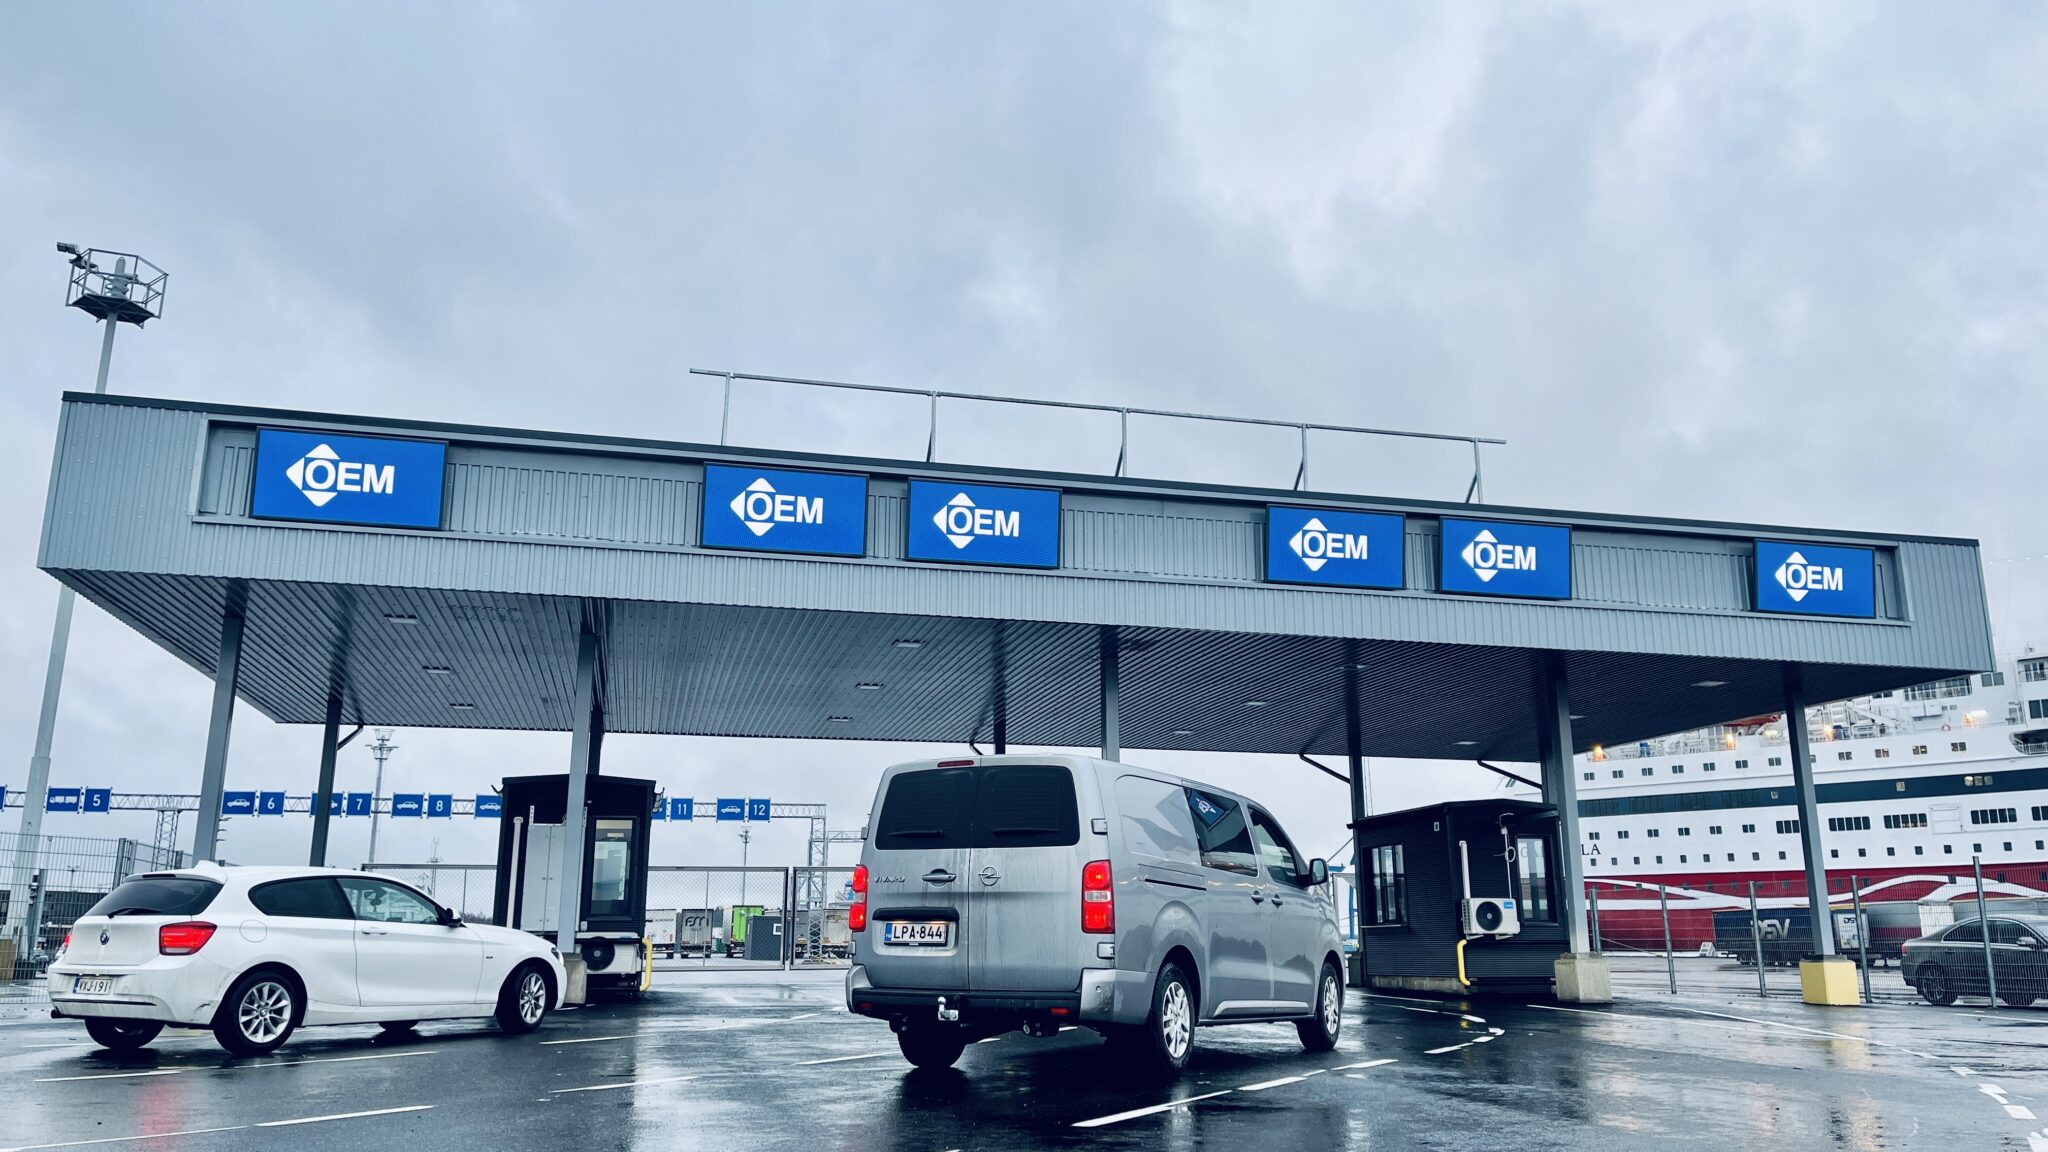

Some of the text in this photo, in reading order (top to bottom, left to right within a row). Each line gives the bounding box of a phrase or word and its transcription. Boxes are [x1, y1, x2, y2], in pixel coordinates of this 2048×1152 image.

[304, 459, 395, 494] OEM
[746, 492, 824, 524] OEM
[948, 507, 1020, 537] OEM
[1302, 531, 1368, 560] OEM
[1474, 543, 1536, 571] OEM
[1786, 564, 1843, 591] OEM
[92, 794, 101, 807] 5
[267, 797, 276, 810] 6
[356, 798, 364, 811] 7
[435, 800, 444, 812] 8
[677, 803, 687, 816] 11
[753, 804, 766, 816] 12
